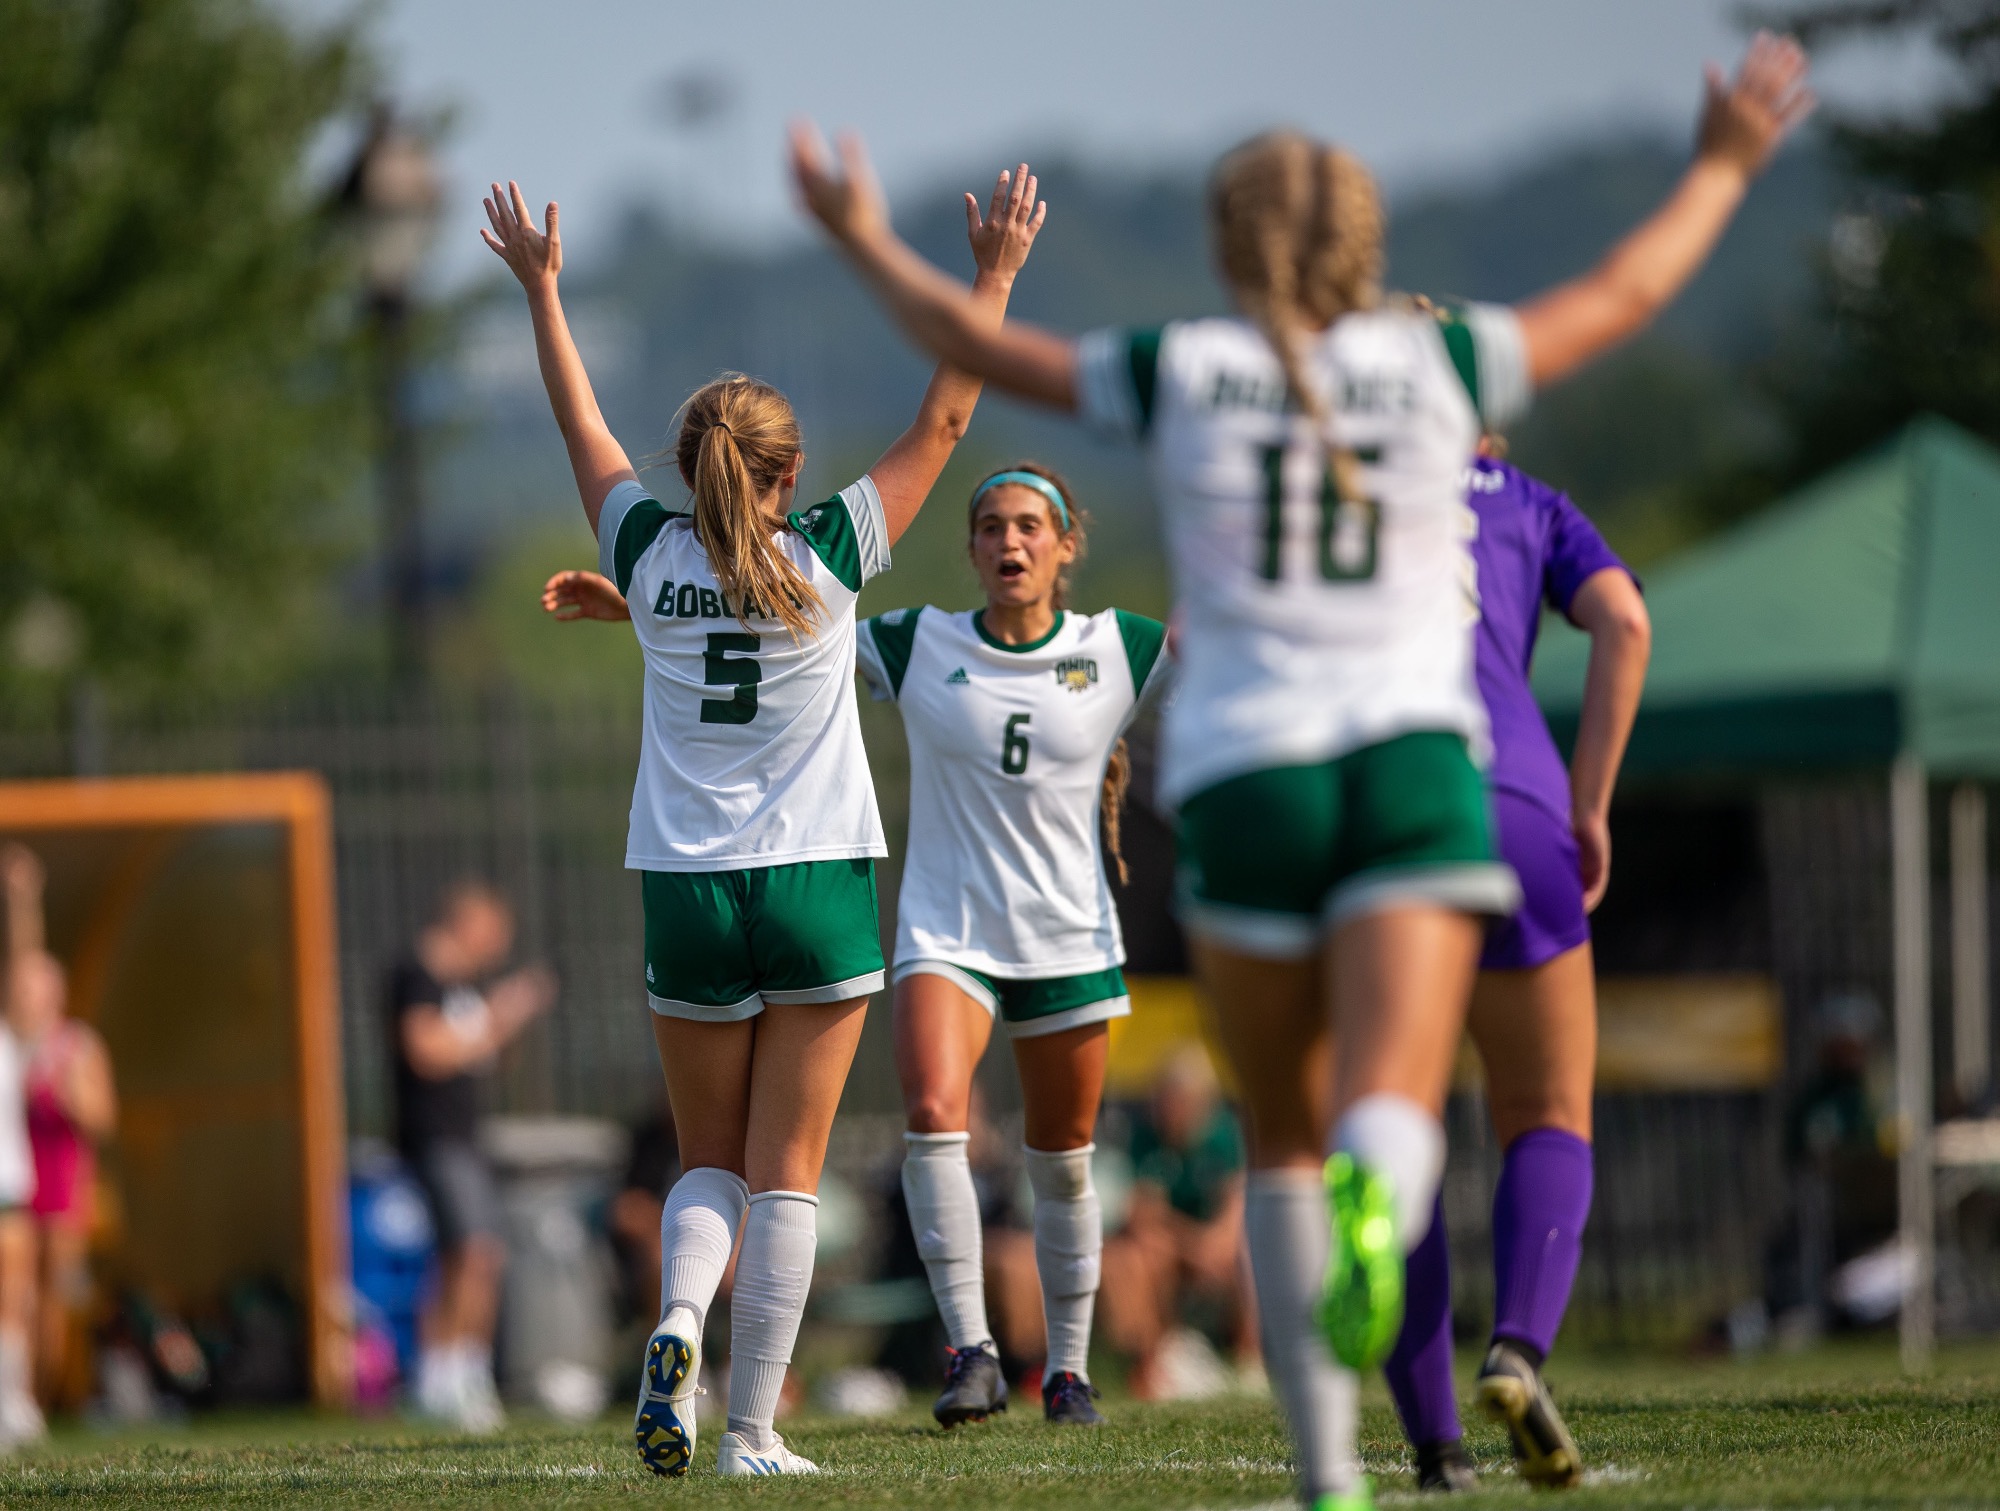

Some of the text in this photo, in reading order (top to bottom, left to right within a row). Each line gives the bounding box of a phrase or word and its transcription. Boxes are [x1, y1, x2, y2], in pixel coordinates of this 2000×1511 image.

[1255, 442, 1381, 582] 16
[700, 632, 762, 725] 5
[1002, 712, 1031, 775] 6
